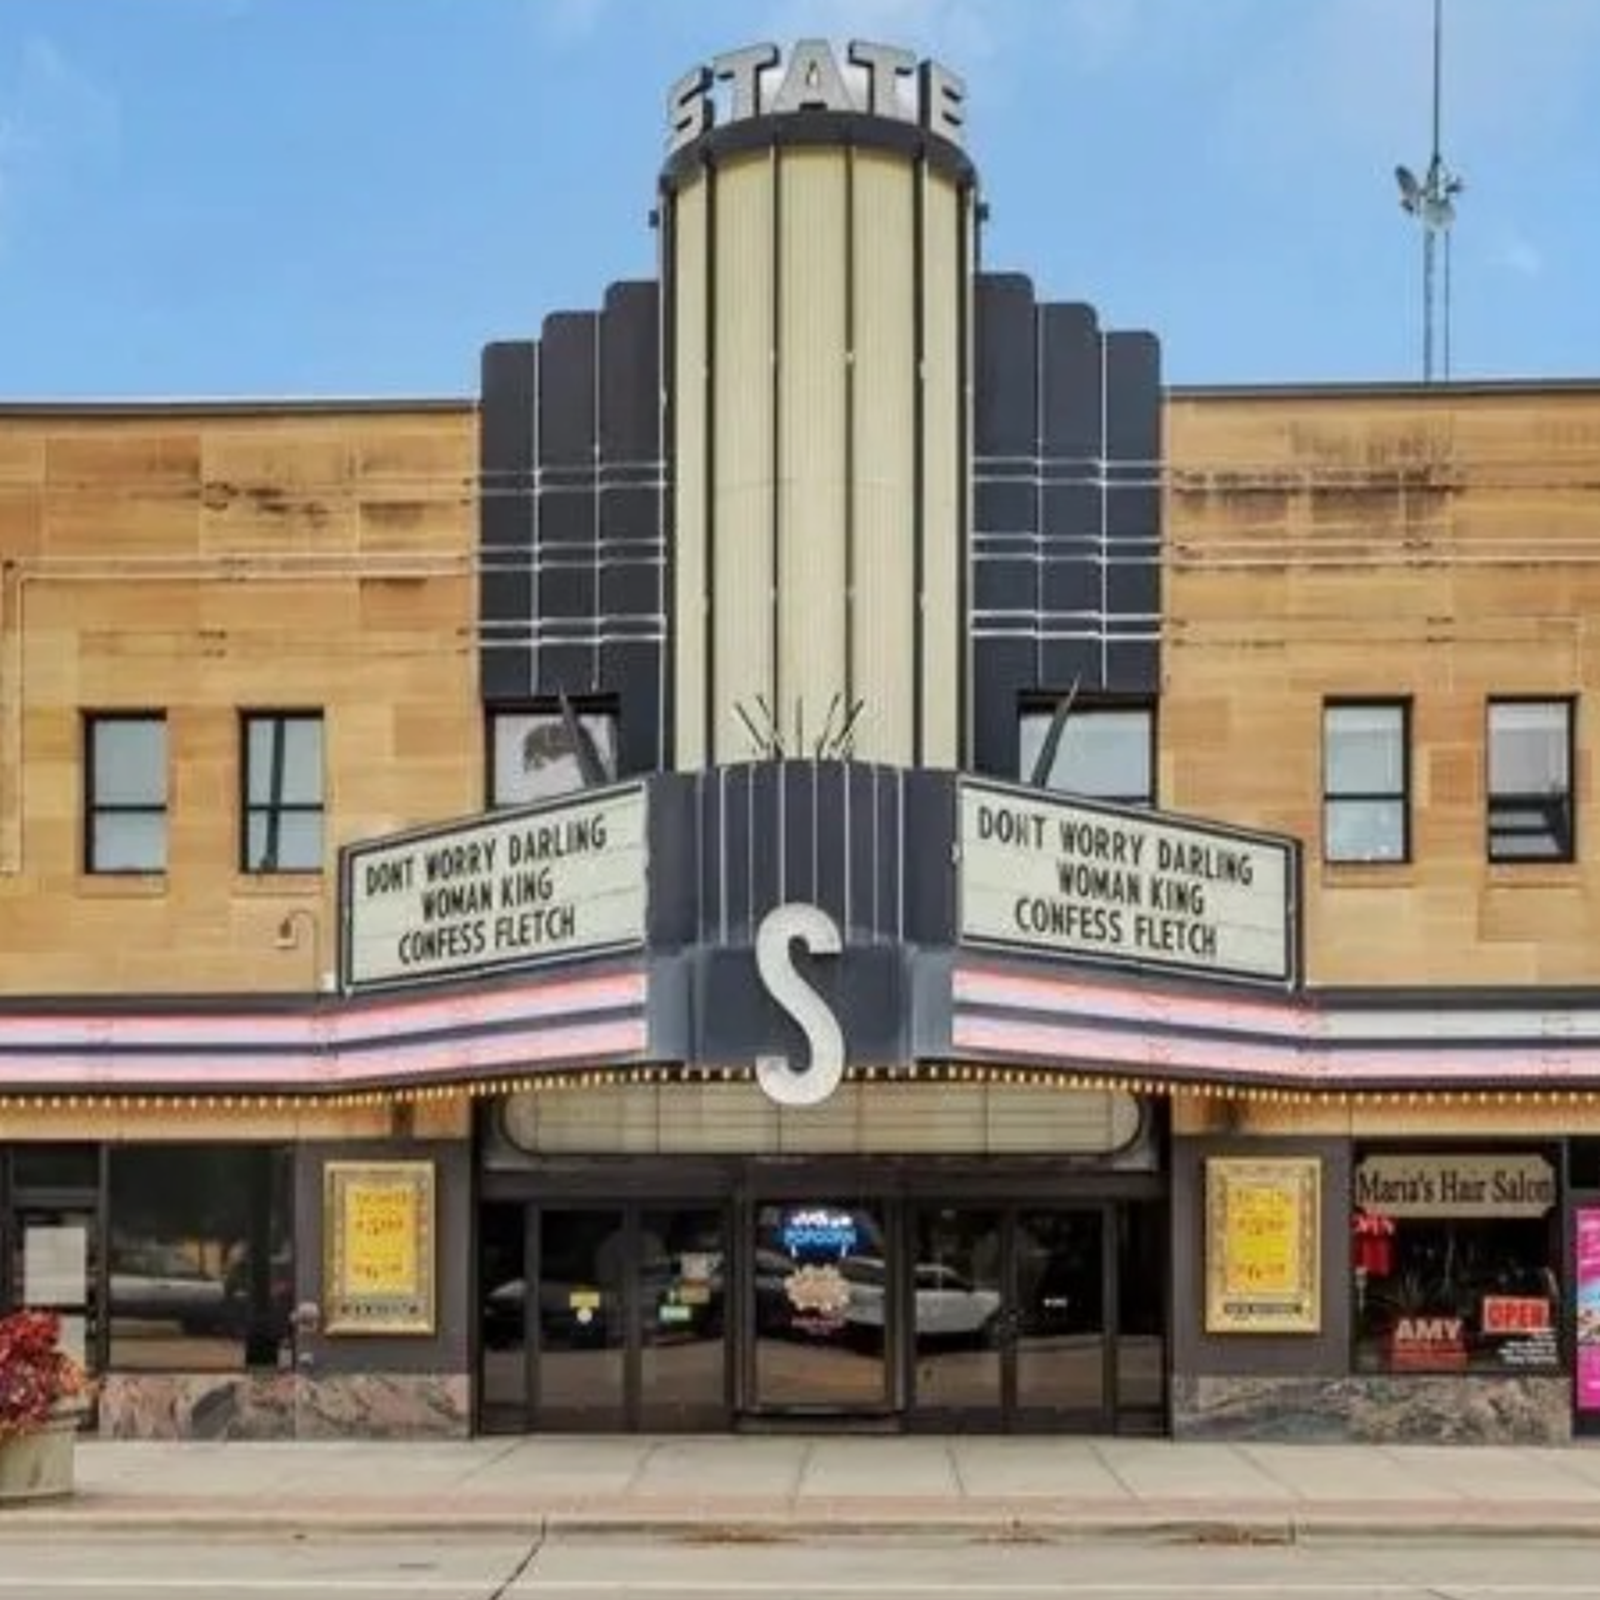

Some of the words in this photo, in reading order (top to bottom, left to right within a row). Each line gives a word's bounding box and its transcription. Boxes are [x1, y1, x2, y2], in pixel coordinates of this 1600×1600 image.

[665, 38, 967, 151] STATE
[366, 855, 414, 897] DONT
[424, 838, 497, 883] WORRY
[508, 813, 607, 868] DARLING
[1060, 820, 1147, 866] WORRY
[1158, 838, 1254, 886] DARLING
[421, 878, 493, 923] WOMAN
[500, 866, 554, 908] KING
[1056, 859, 1142, 905] WOMAN
[1151, 875, 1205, 916] KING
[399, 920, 487, 965] CONFESS
[494, 904, 576, 950] FLETCH
[1015, 896, 1123, 944] CONFESS
[1134, 915, 1218, 956] FLETCH
[755, 902, 845, 1105] S
[1441, 1169, 1487, 1203] Hair
[1492, 1168, 1551, 1203] Salon
[1396, 1318, 1462, 1341] AMY
